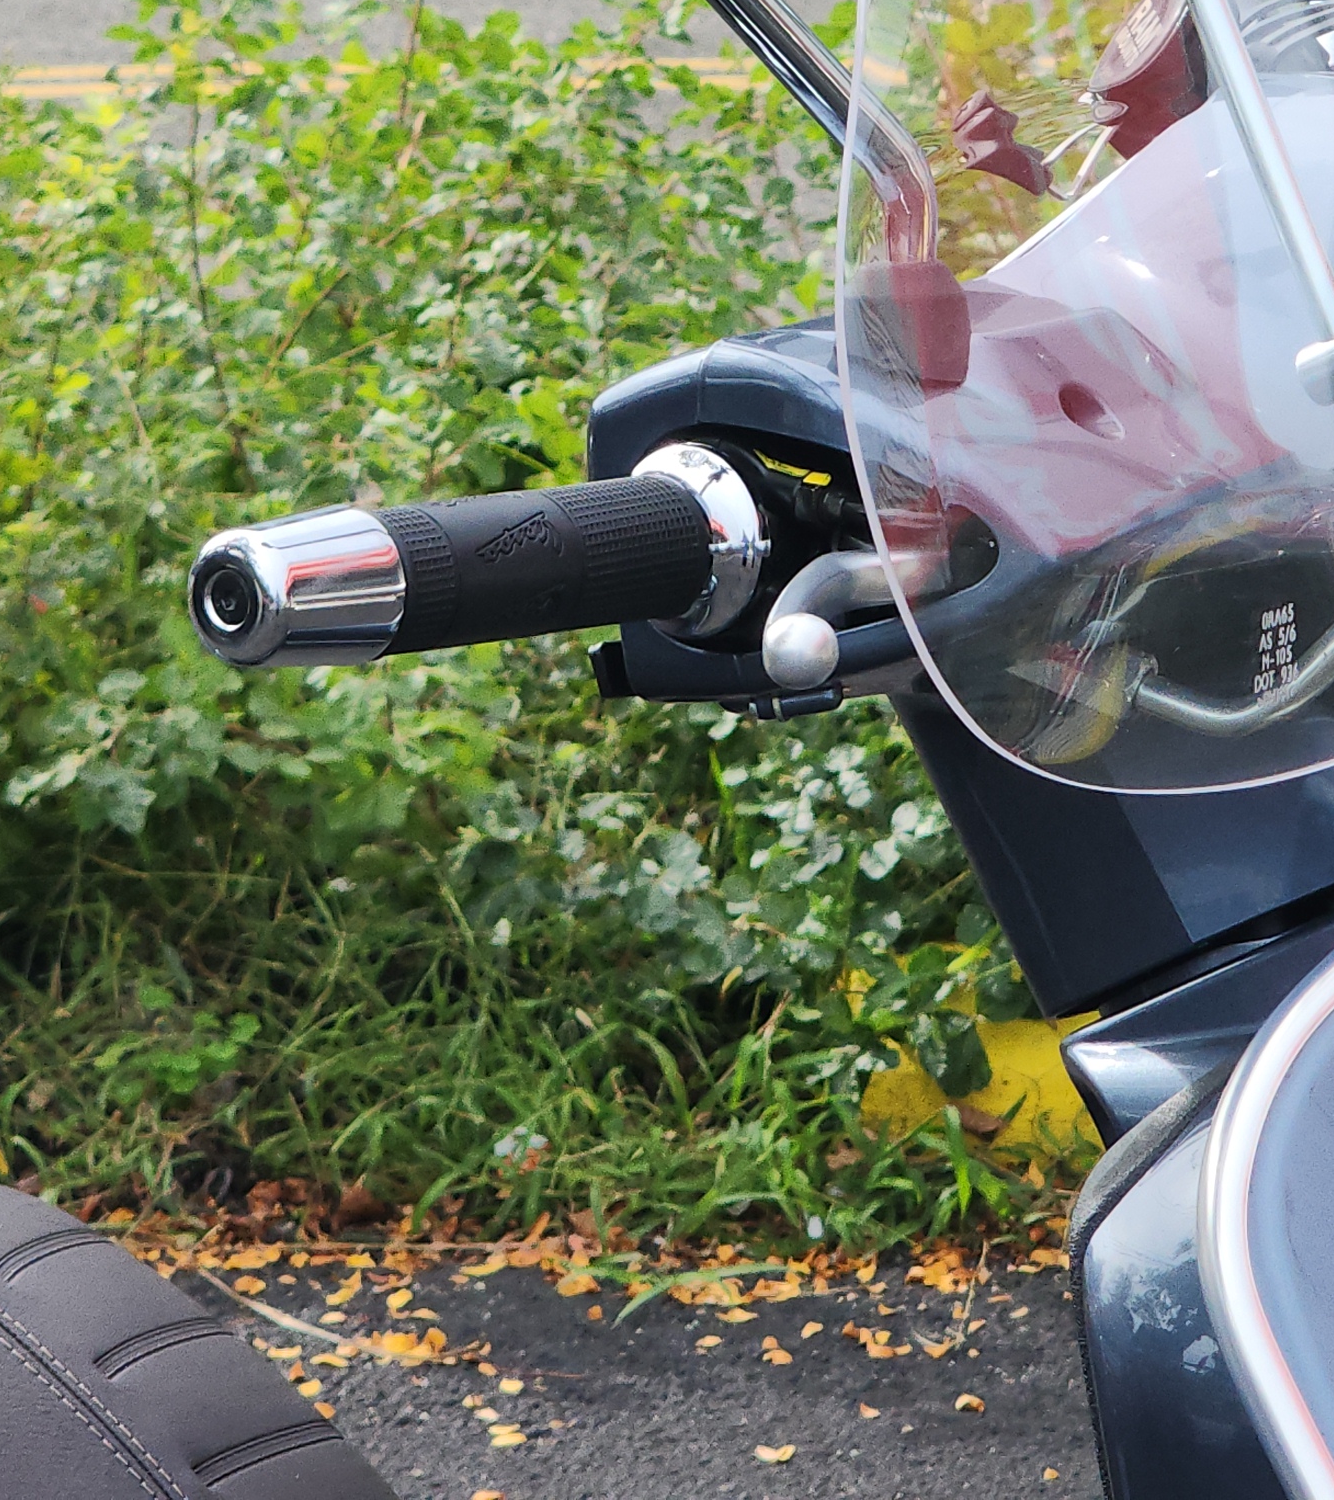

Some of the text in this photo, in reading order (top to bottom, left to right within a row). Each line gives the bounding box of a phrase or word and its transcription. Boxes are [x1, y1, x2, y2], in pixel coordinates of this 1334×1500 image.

[1258, 623, 1297, 653] AS 5/6
[1253, 670, 1276, 694] DOT
